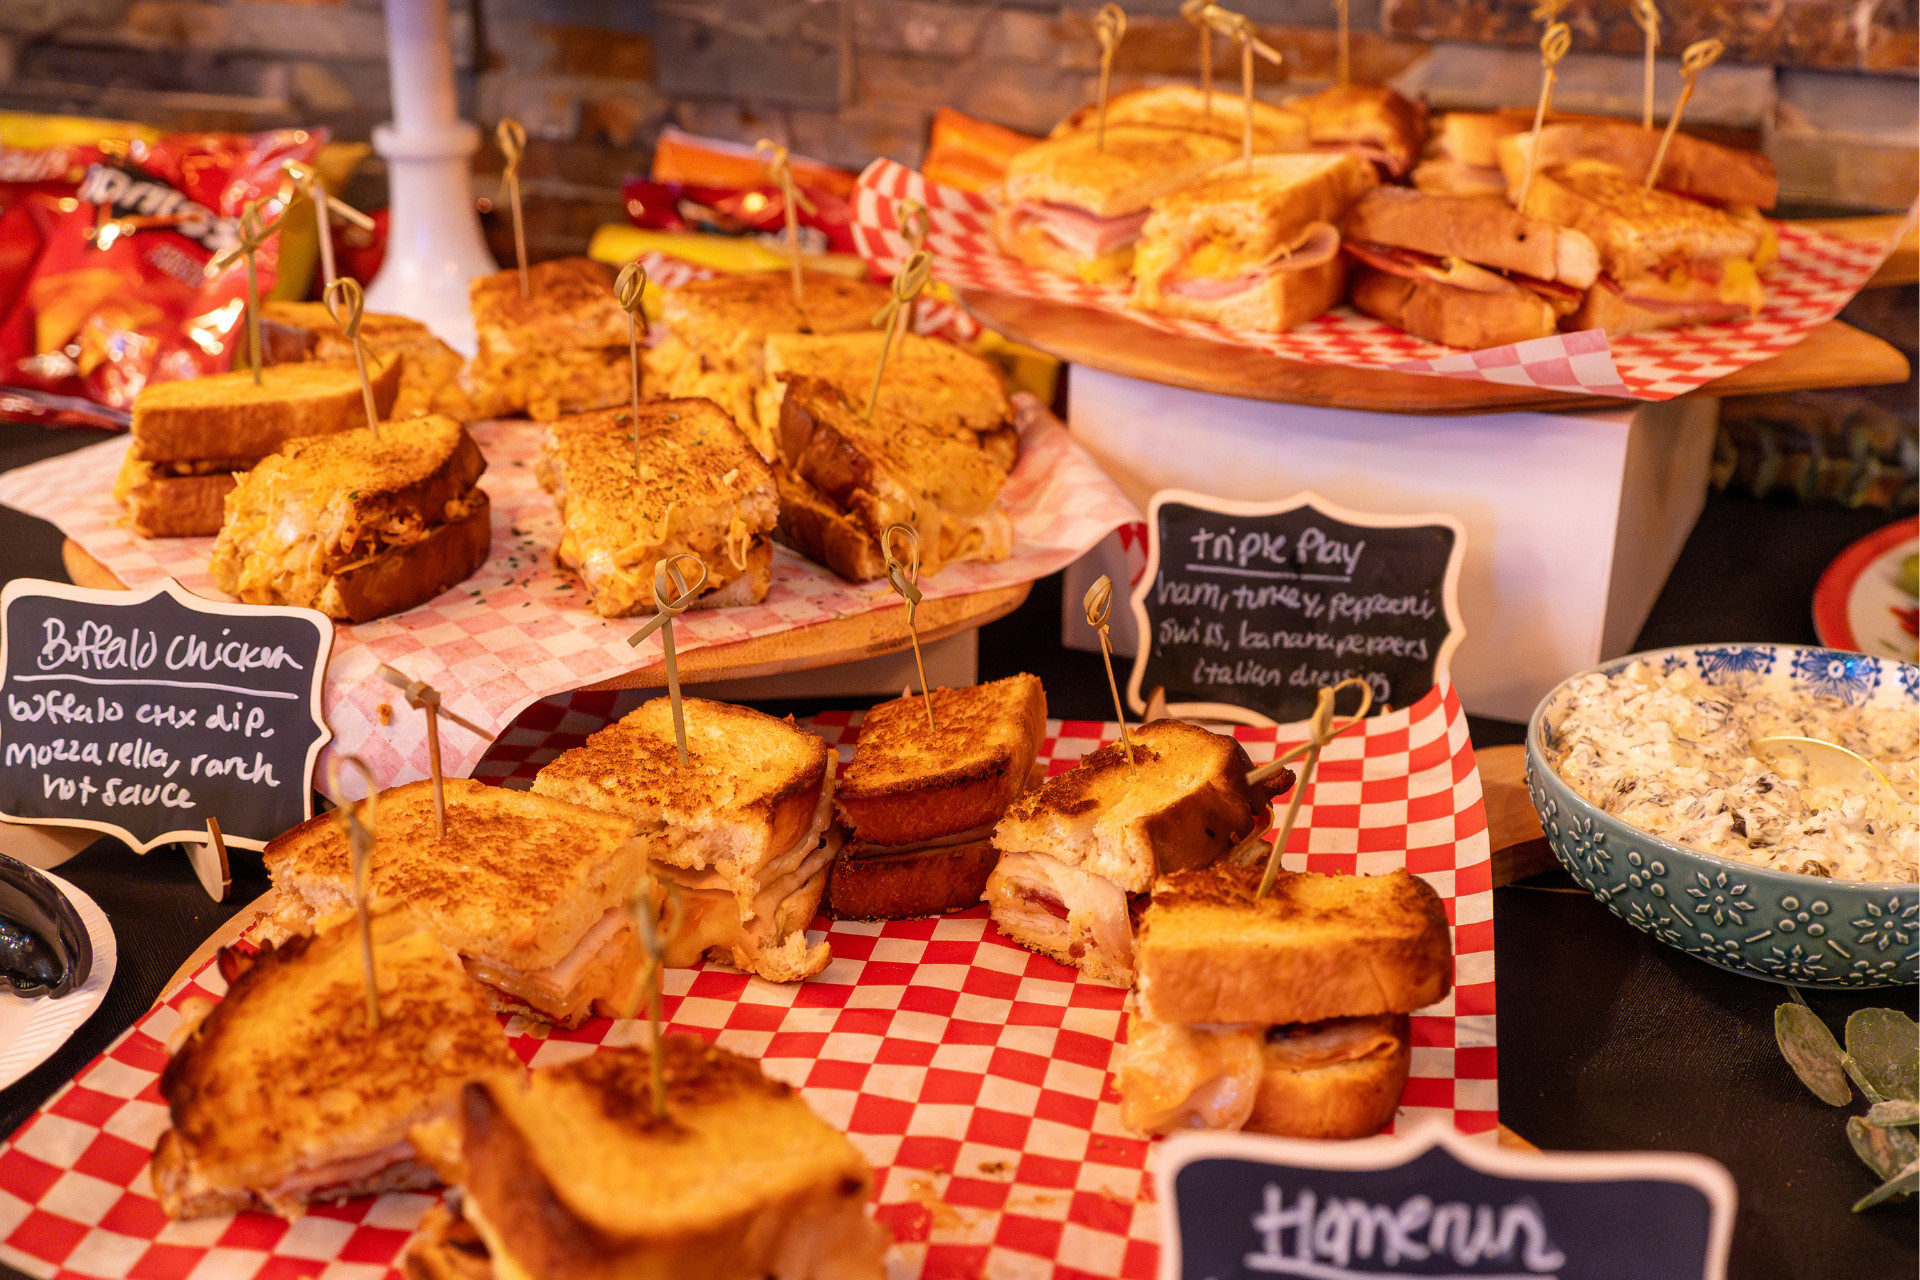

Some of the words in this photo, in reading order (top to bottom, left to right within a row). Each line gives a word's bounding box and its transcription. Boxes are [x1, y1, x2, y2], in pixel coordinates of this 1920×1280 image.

[1297, 527, 1366, 575] Play
[1158, 571, 1230, 612] ham,
[37, 617, 157, 671] Buffalo
[8, 690, 124, 725] buffalo
[205, 702, 275, 737] dip,
[43, 773, 99, 806] hot
[101, 778, 196, 808] sauce
[190, 752, 281, 787] ranch
[1252, 1183, 1567, 1272] Homerun
